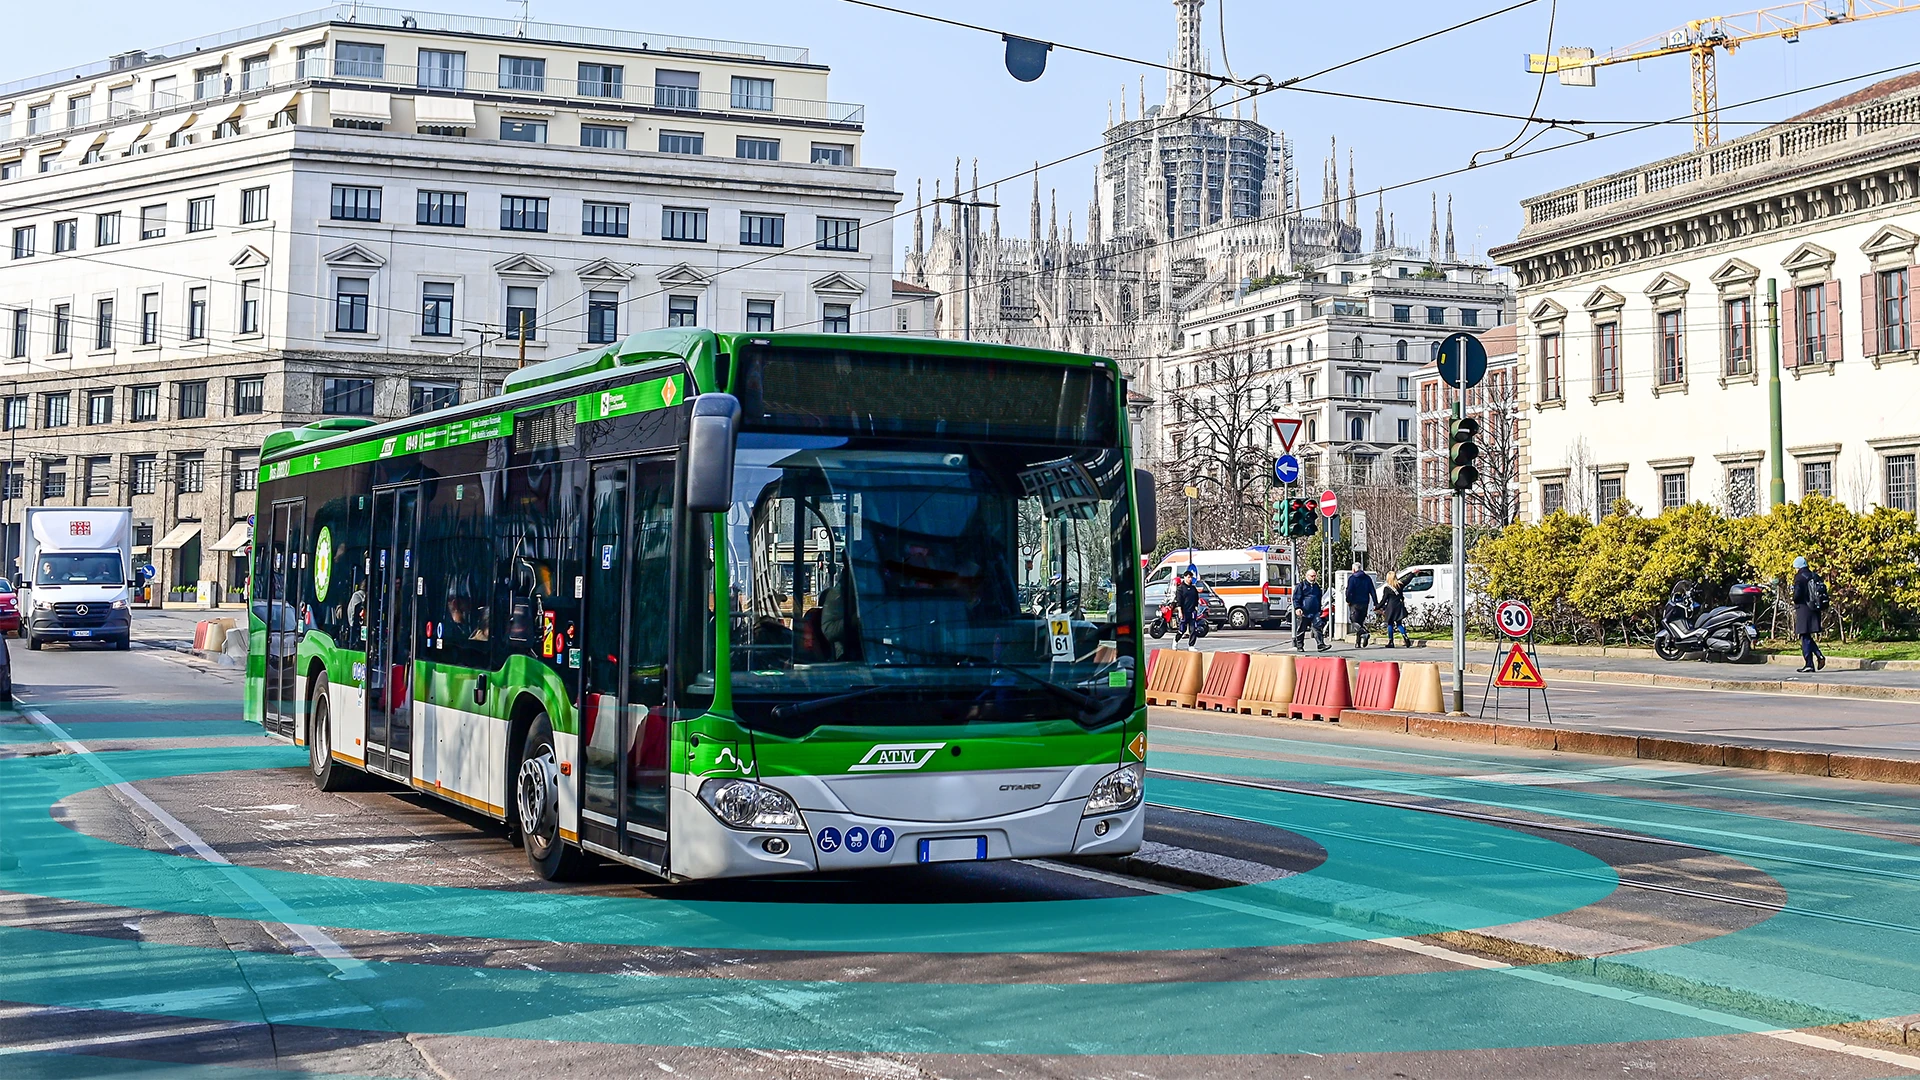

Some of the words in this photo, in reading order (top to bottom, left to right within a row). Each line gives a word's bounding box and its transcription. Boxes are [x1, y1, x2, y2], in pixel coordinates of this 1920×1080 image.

[1503, 610, 1526, 627] 30
[1056, 622, 1064, 635] 2
[1055, 637, 1068, 651] 61
[877, 750, 916, 764] ATM
[999, 783, 1041, 791] CITARO
